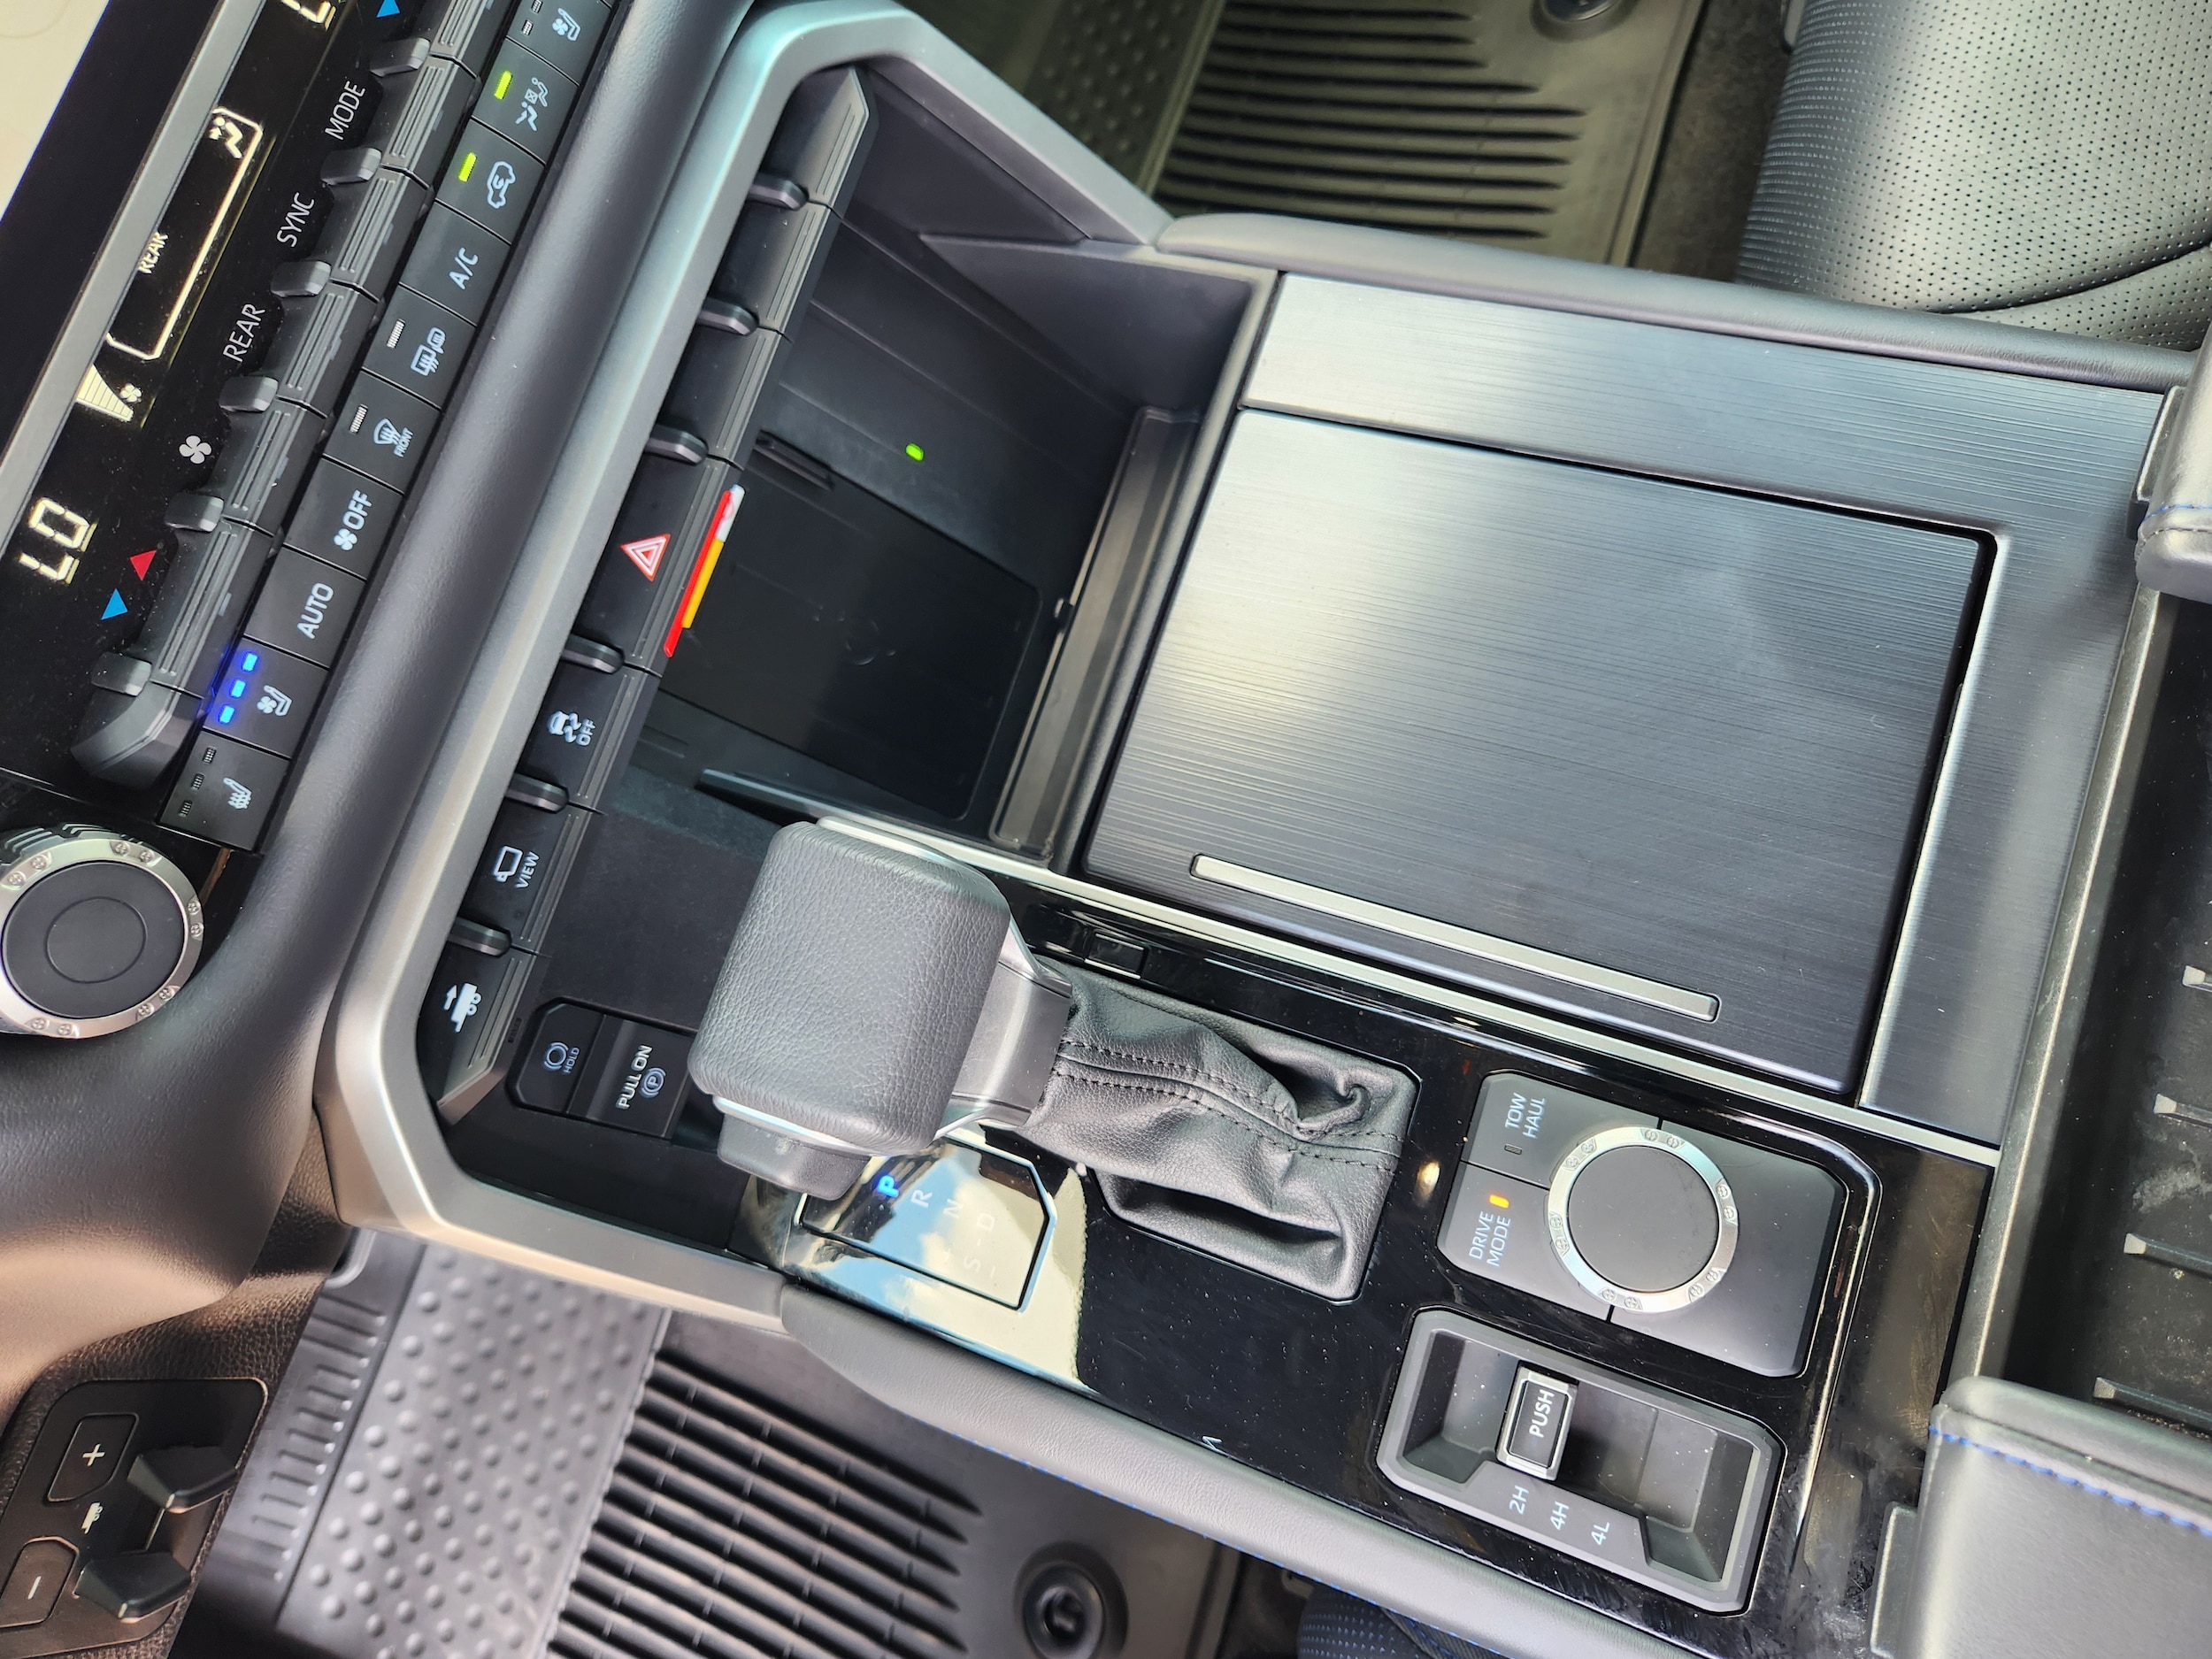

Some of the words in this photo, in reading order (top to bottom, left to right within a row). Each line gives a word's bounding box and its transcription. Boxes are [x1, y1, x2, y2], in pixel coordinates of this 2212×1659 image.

[324, 81, 366, 141] MODE
[276, 192, 315, 248] SYNC
[138, 231, 168, 274] REAR
[449, 247, 479, 290] A/C
[223, 303, 265, 363] REAR
[393, 426, 414, 458] FRONT
[342, 489, 373, 531] OFF
[296, 582, 334, 640] AUTO
[576, 718, 596, 747] OFF
[515, 851, 540, 889] VIEW
[563, 1046, 580, 1075] HOLD
[615, 1073, 642, 1110] PULL
[630, 1044, 653, 1072] ON
[1504, 1092, 1527, 1130] TOW
[1523, 1097, 1546, 1140] HAUL
[876, 1175, 899, 1198] P
[910, 1188, 933, 1209] R
[942, 1198, 964, 1220] N
[976, 1212, 996, 1233] D
[1468, 1210, 1494, 1261] DRIVE
[1486, 1216, 1512, 1268] MODE
[963, 1255, 982, 1273] S
[1529, 1388, 1555, 1438] PUSH
[1509, 1485, 1530, 1515] 2H
[1549, 1501, 1570, 1532] 4H
[1591, 1522, 1611, 1547] 4L
